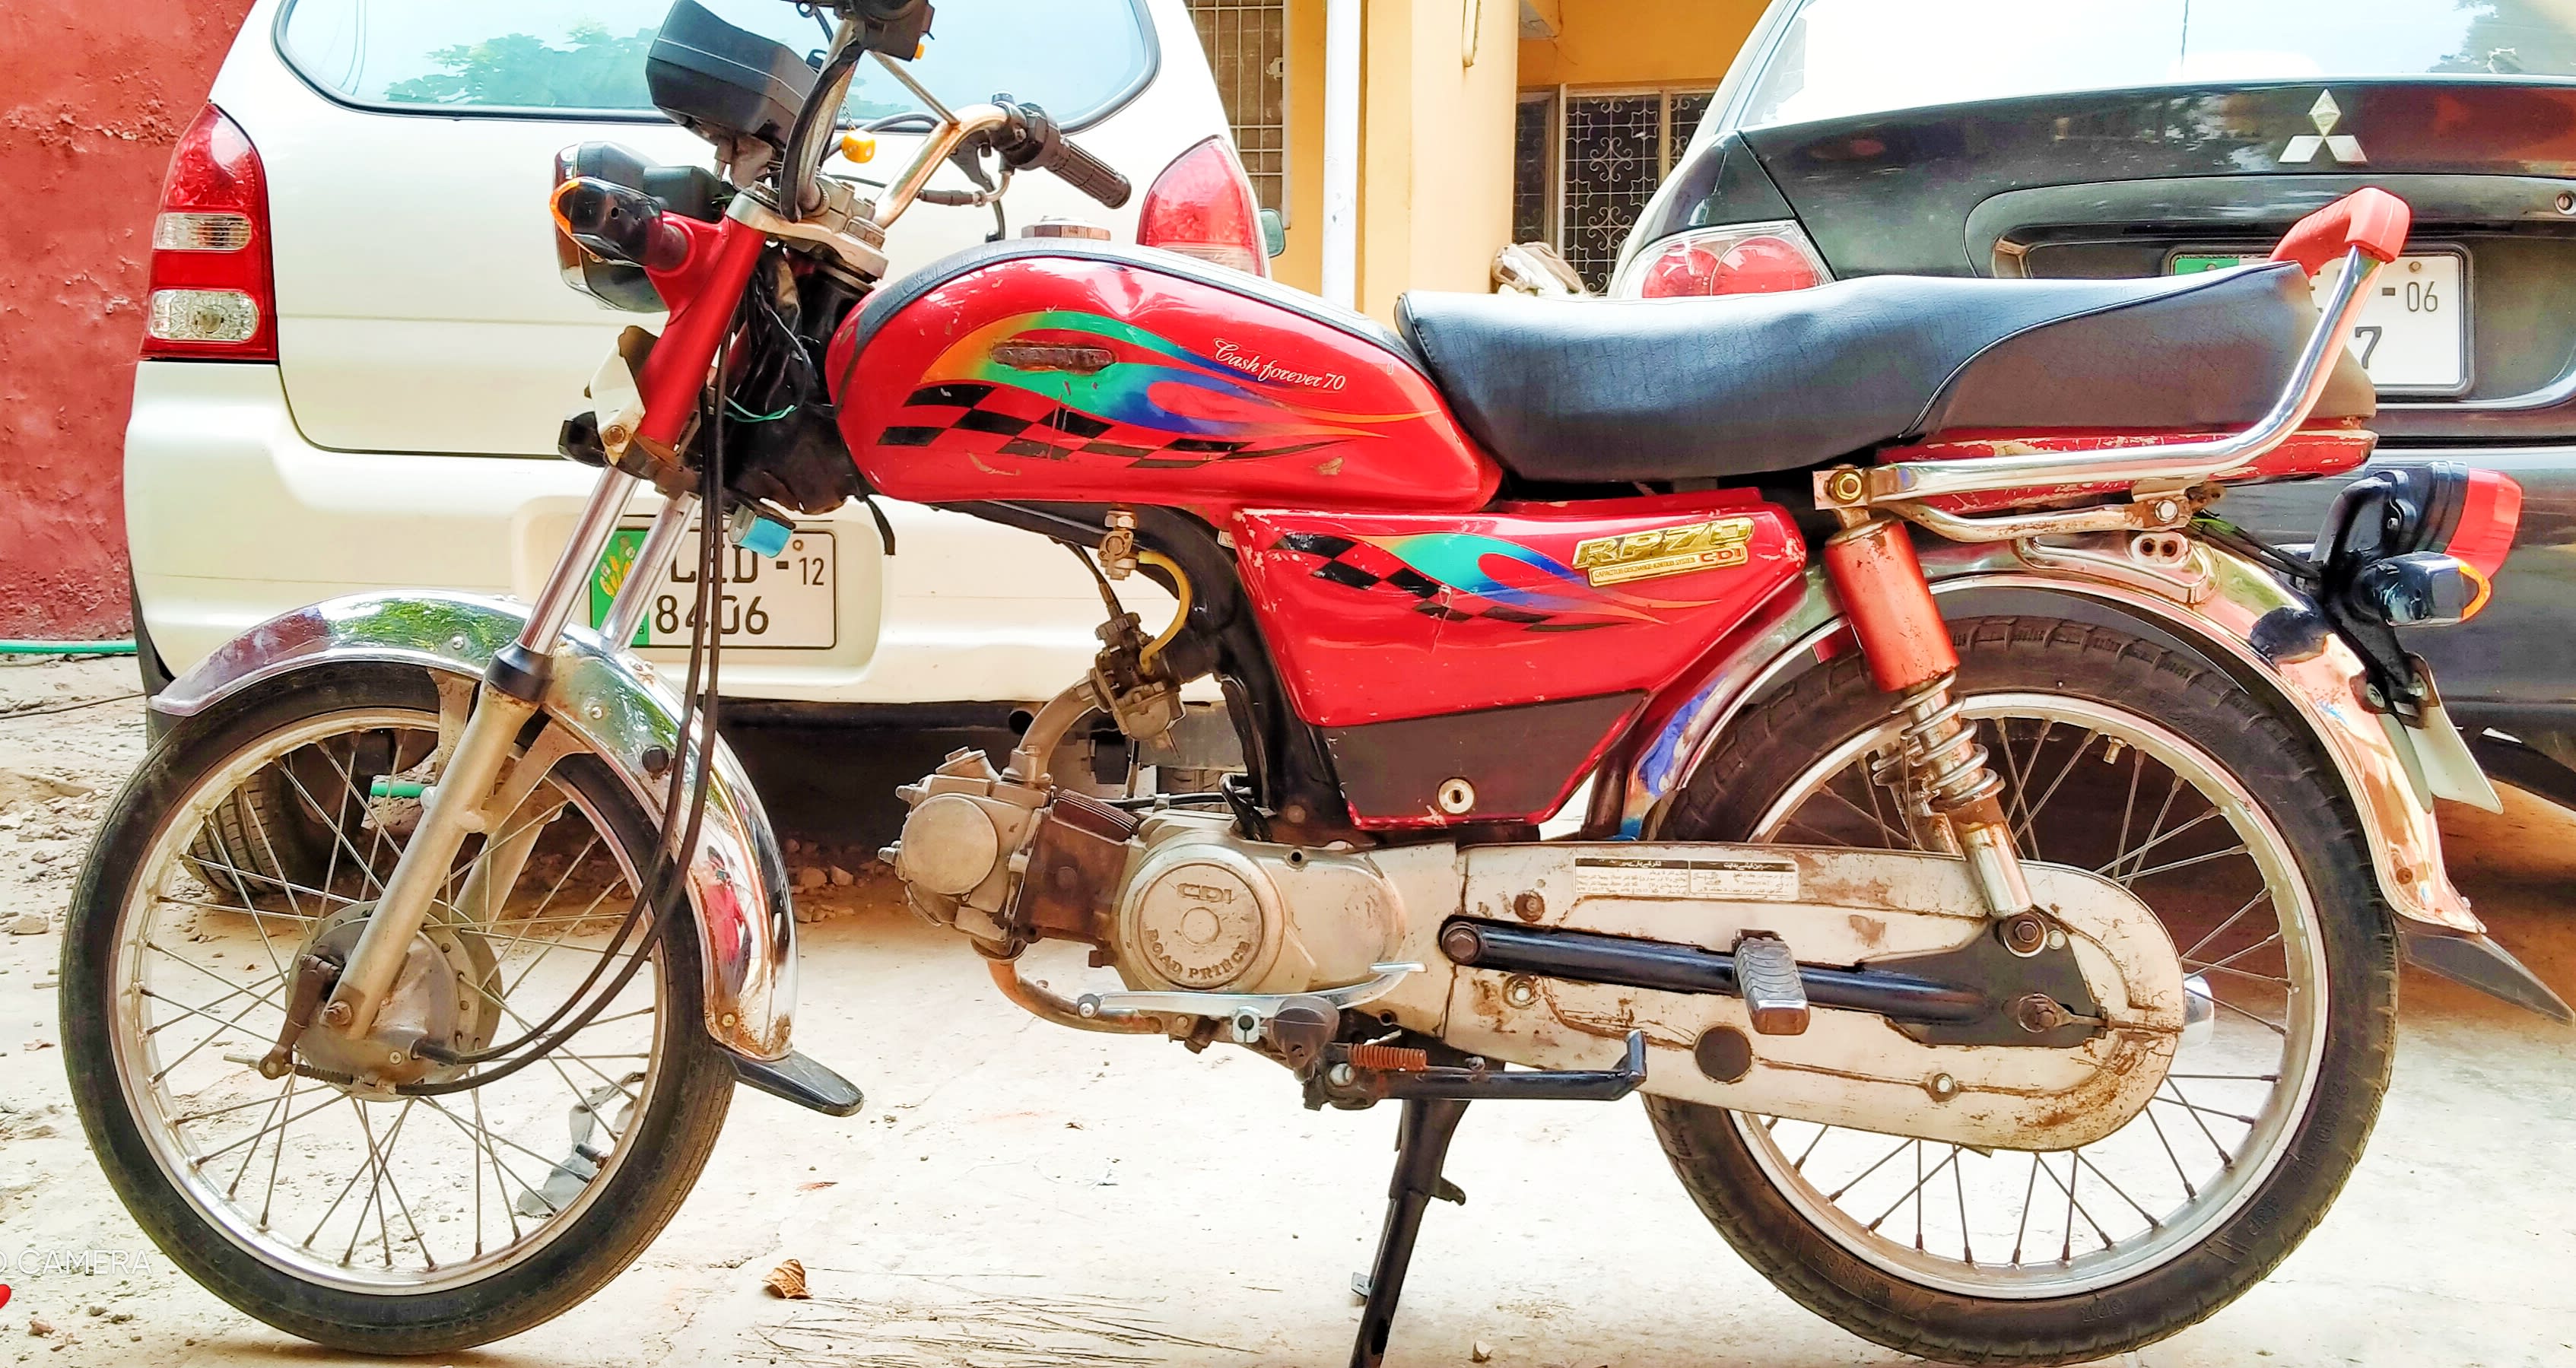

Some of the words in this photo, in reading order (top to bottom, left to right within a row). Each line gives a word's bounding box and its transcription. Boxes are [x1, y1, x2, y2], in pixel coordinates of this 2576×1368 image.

[1257, 360, 1323, 386] forever
[1322, 372, 1346, 390] 70
[1699, 548, 1743, 563] CDI
[1177, 882, 1233, 904] CDI
[1144, 928, 1183, 973] ROAD
[1188, 941, 1250, 980] PRINCE
